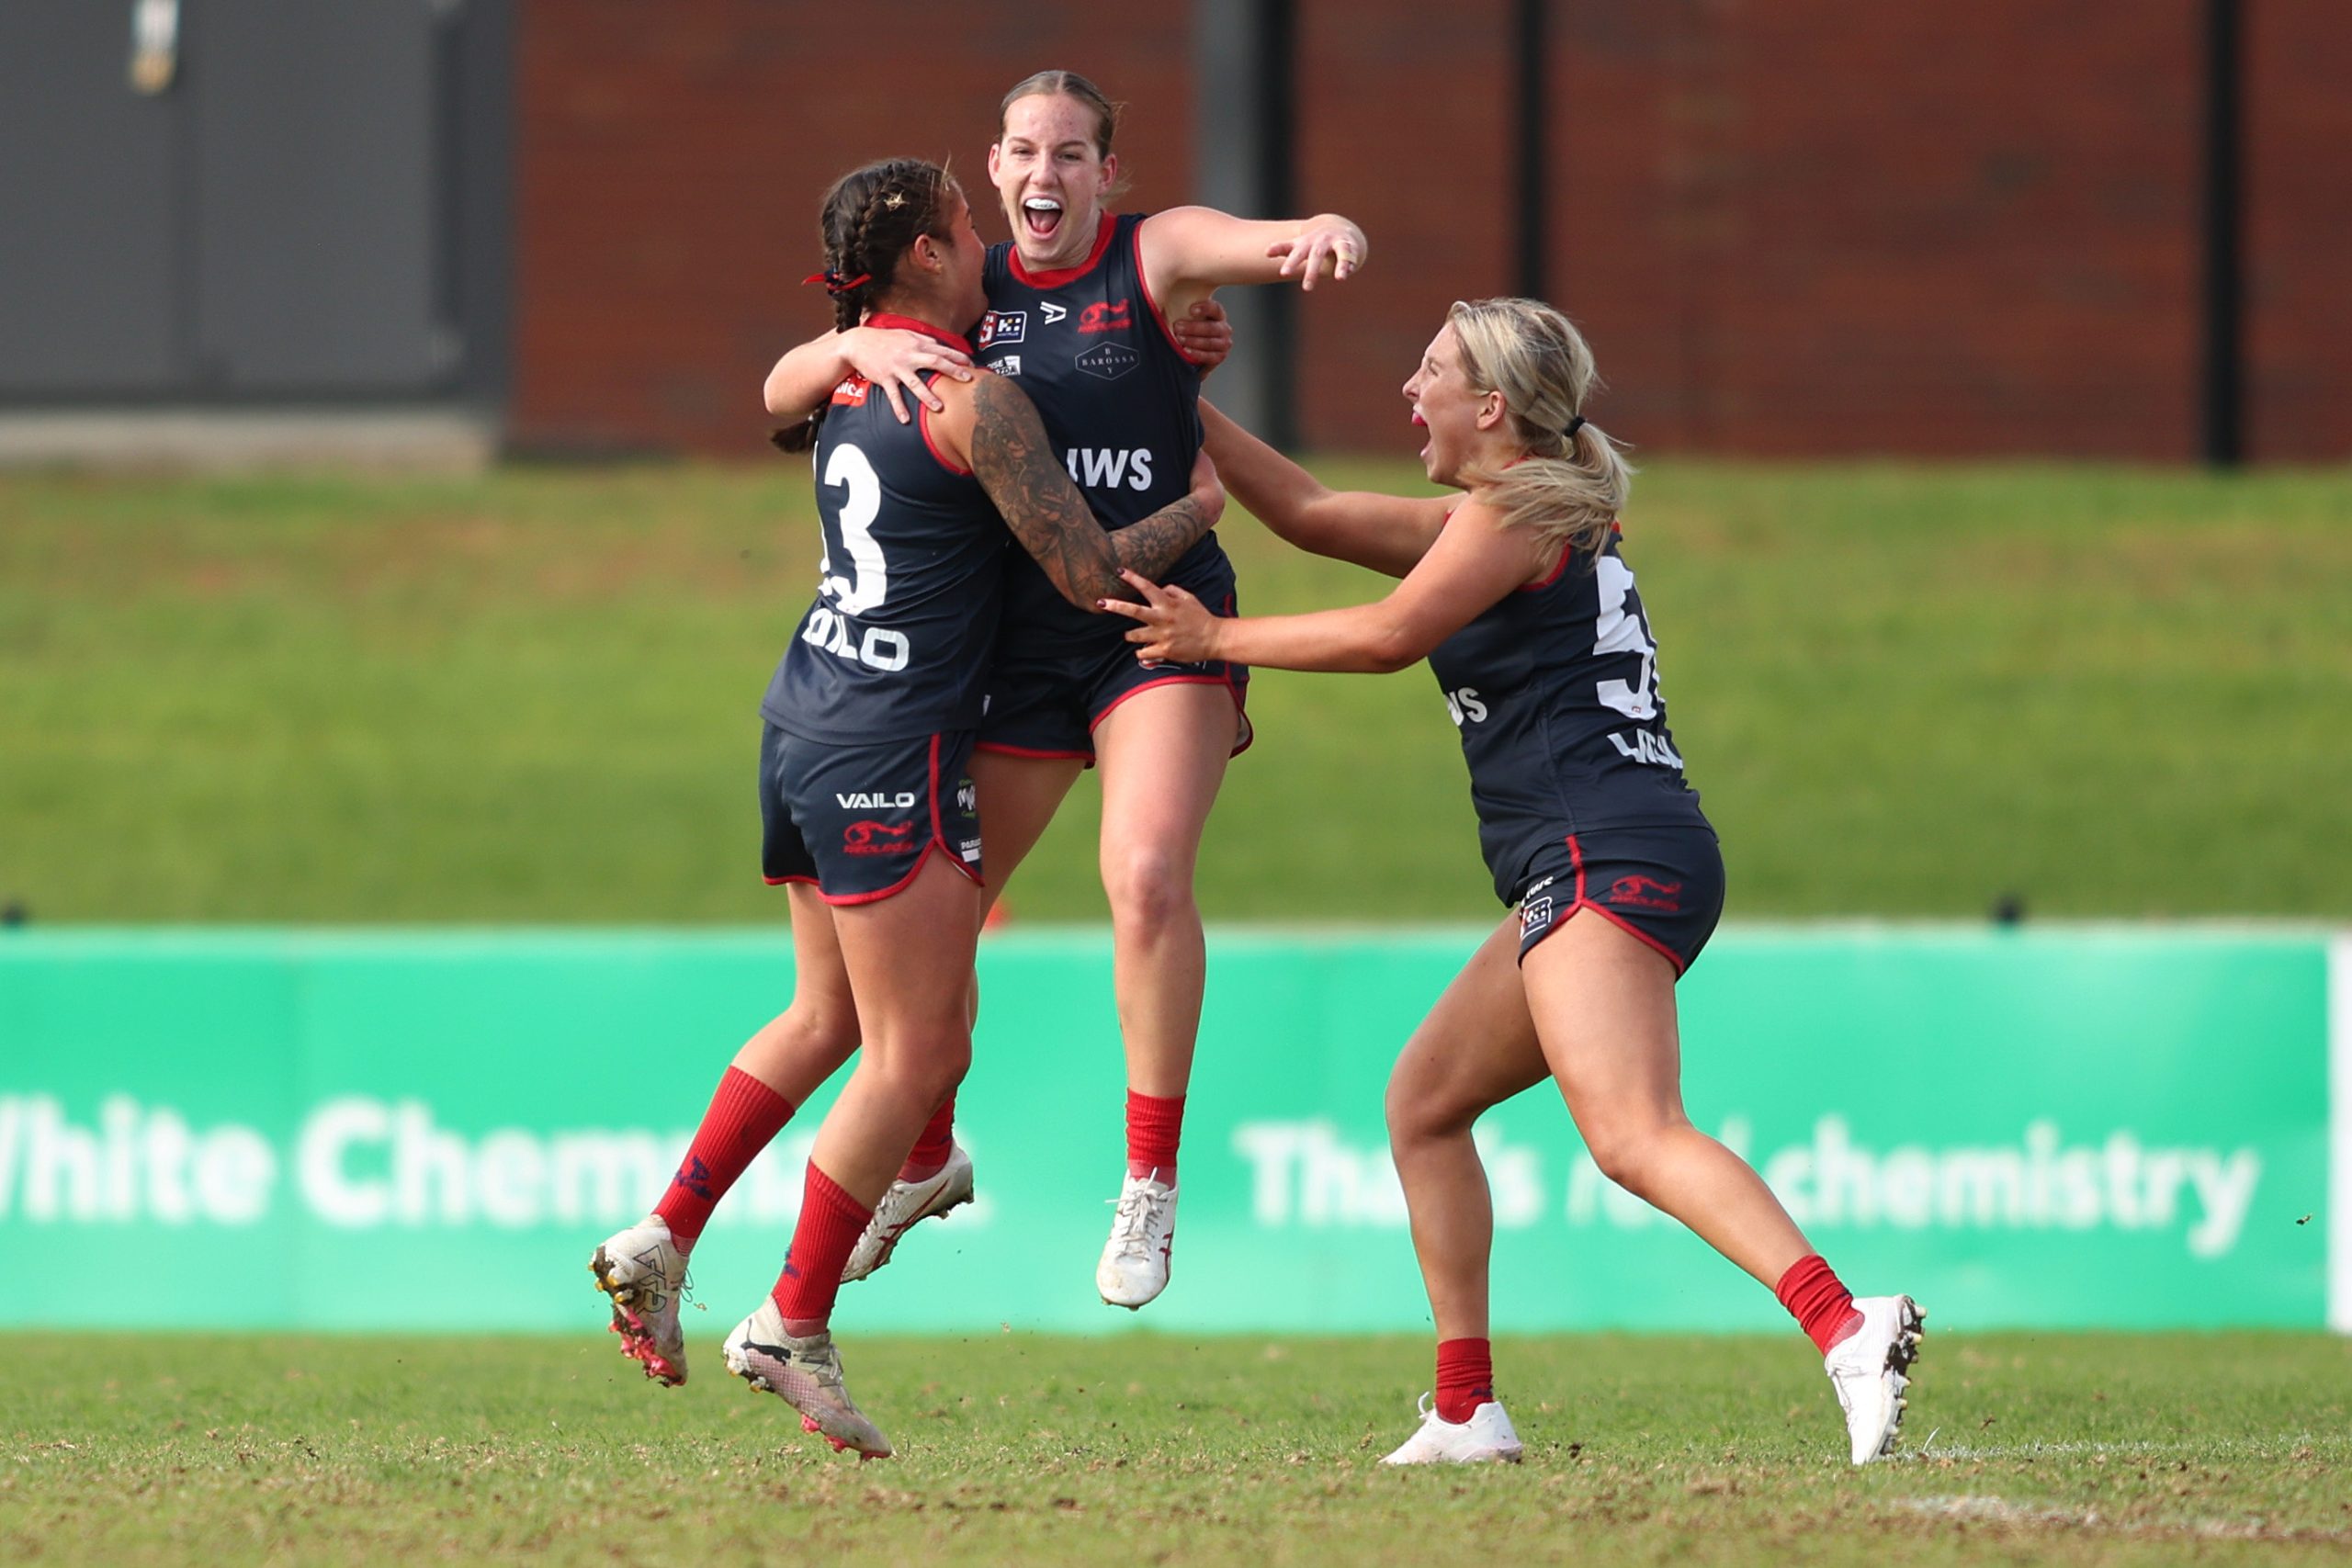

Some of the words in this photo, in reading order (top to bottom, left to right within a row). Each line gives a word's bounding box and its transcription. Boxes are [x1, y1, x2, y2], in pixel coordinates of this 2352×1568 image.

[812, 441, 888, 616] 3
[1593, 556, 1666, 721] 5
[835, 792, 915, 809] VAILO
